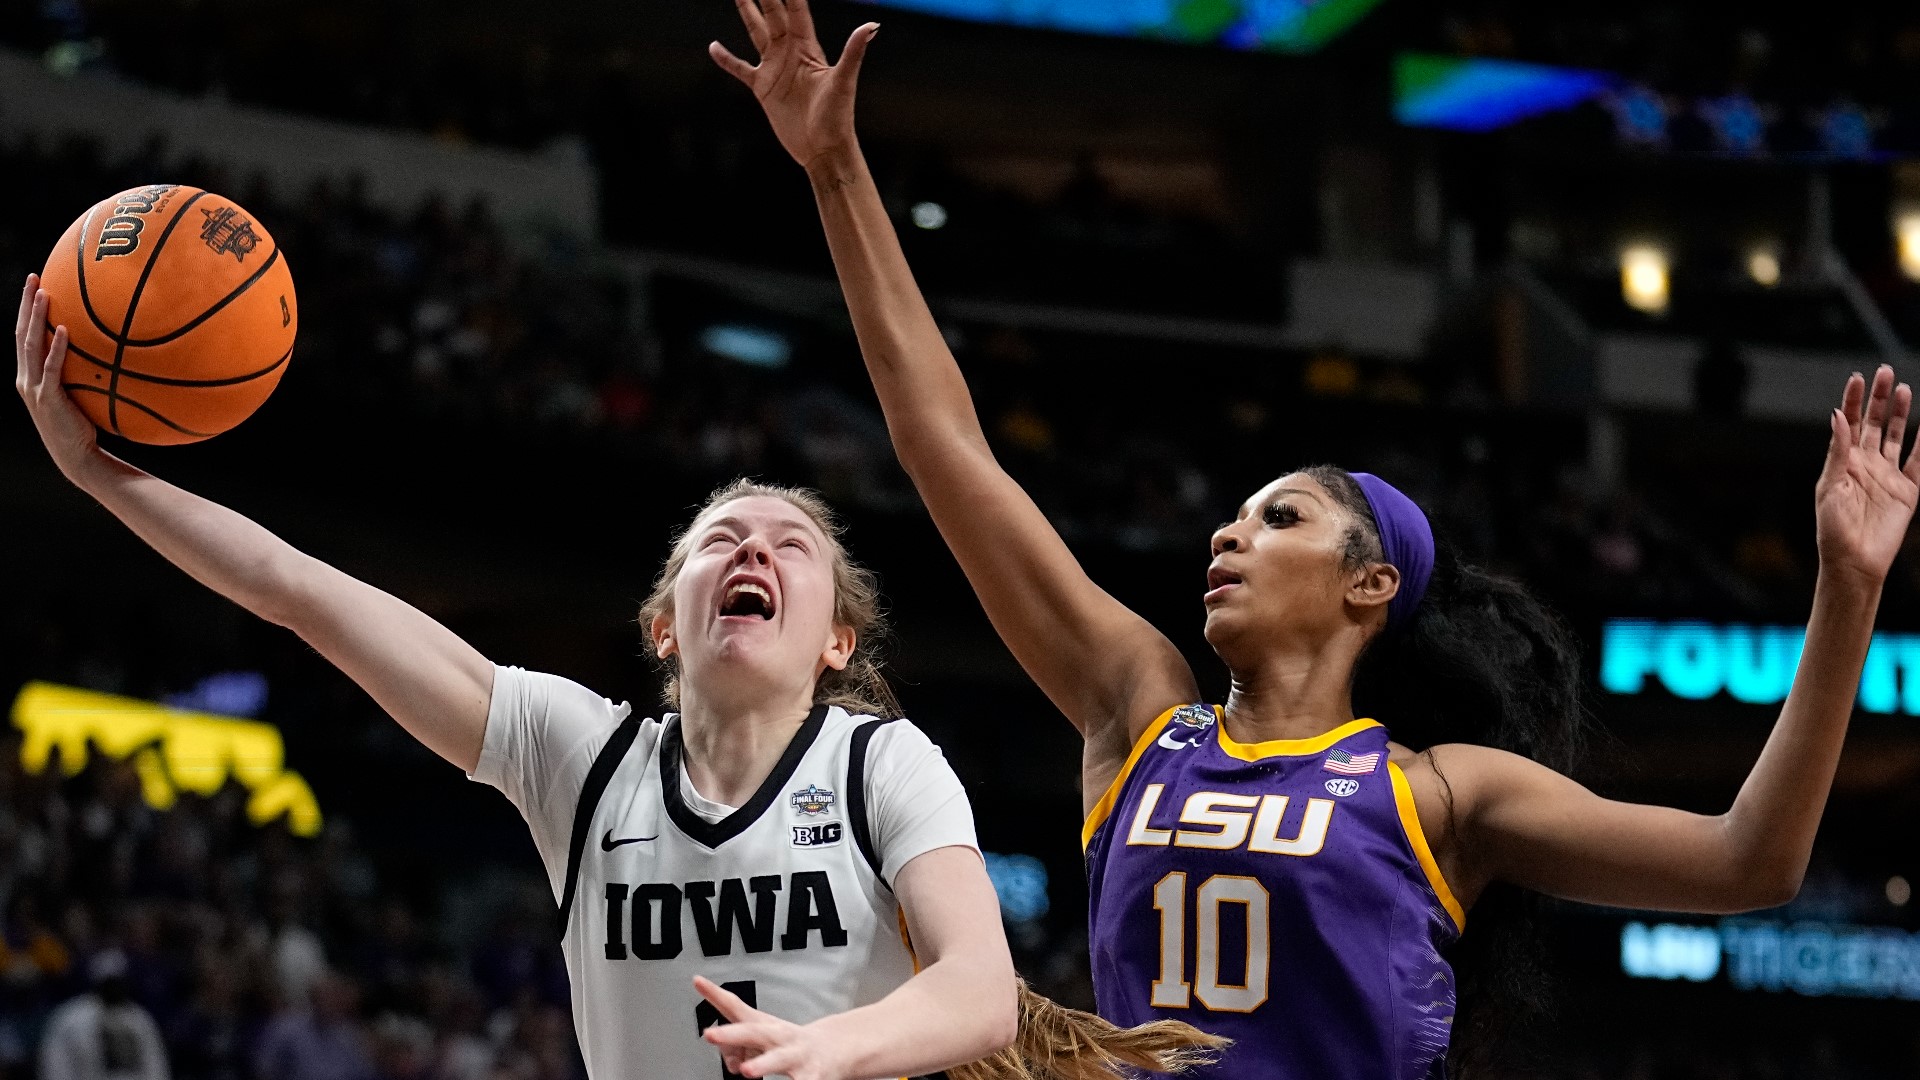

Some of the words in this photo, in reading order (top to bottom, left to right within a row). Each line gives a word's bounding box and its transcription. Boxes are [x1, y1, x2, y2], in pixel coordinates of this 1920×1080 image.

[95, 184, 180, 262] Wil
[1174, 709, 1194, 717] FINAL
[1194, 712, 1213, 723] FOUR
[792, 794, 813, 805] FINAL
[814, 794, 834, 803] FOUR
[1126, 784, 1335, 857] LSU
[1327, 779, 1357, 796] SEC
[604, 870, 848, 961] IOWA
[1150, 871, 1271, 1014] 10
